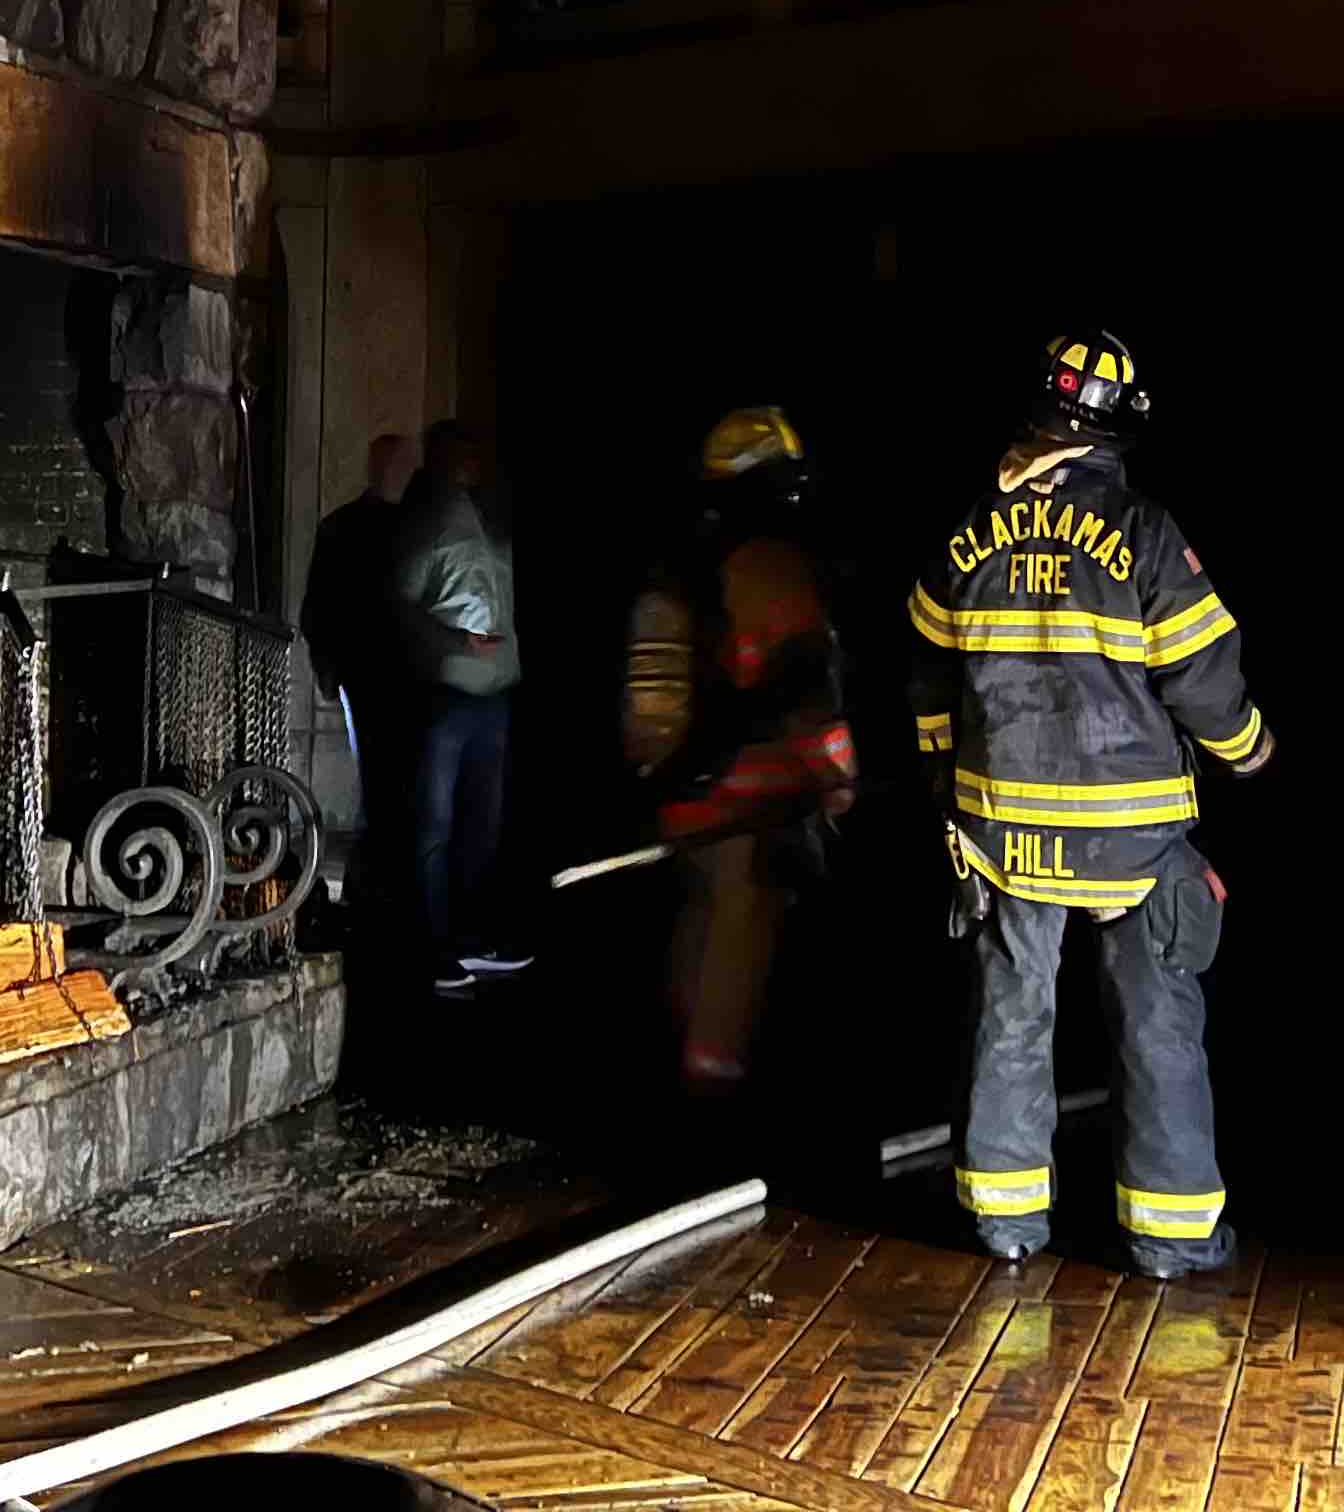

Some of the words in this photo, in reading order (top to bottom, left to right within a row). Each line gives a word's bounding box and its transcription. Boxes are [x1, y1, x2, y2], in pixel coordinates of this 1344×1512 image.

[949, 499, 1133, 582] CLACKAMAS
[1009, 553, 1072, 595] FIRE
[1003, 830, 1074, 878] HILL
